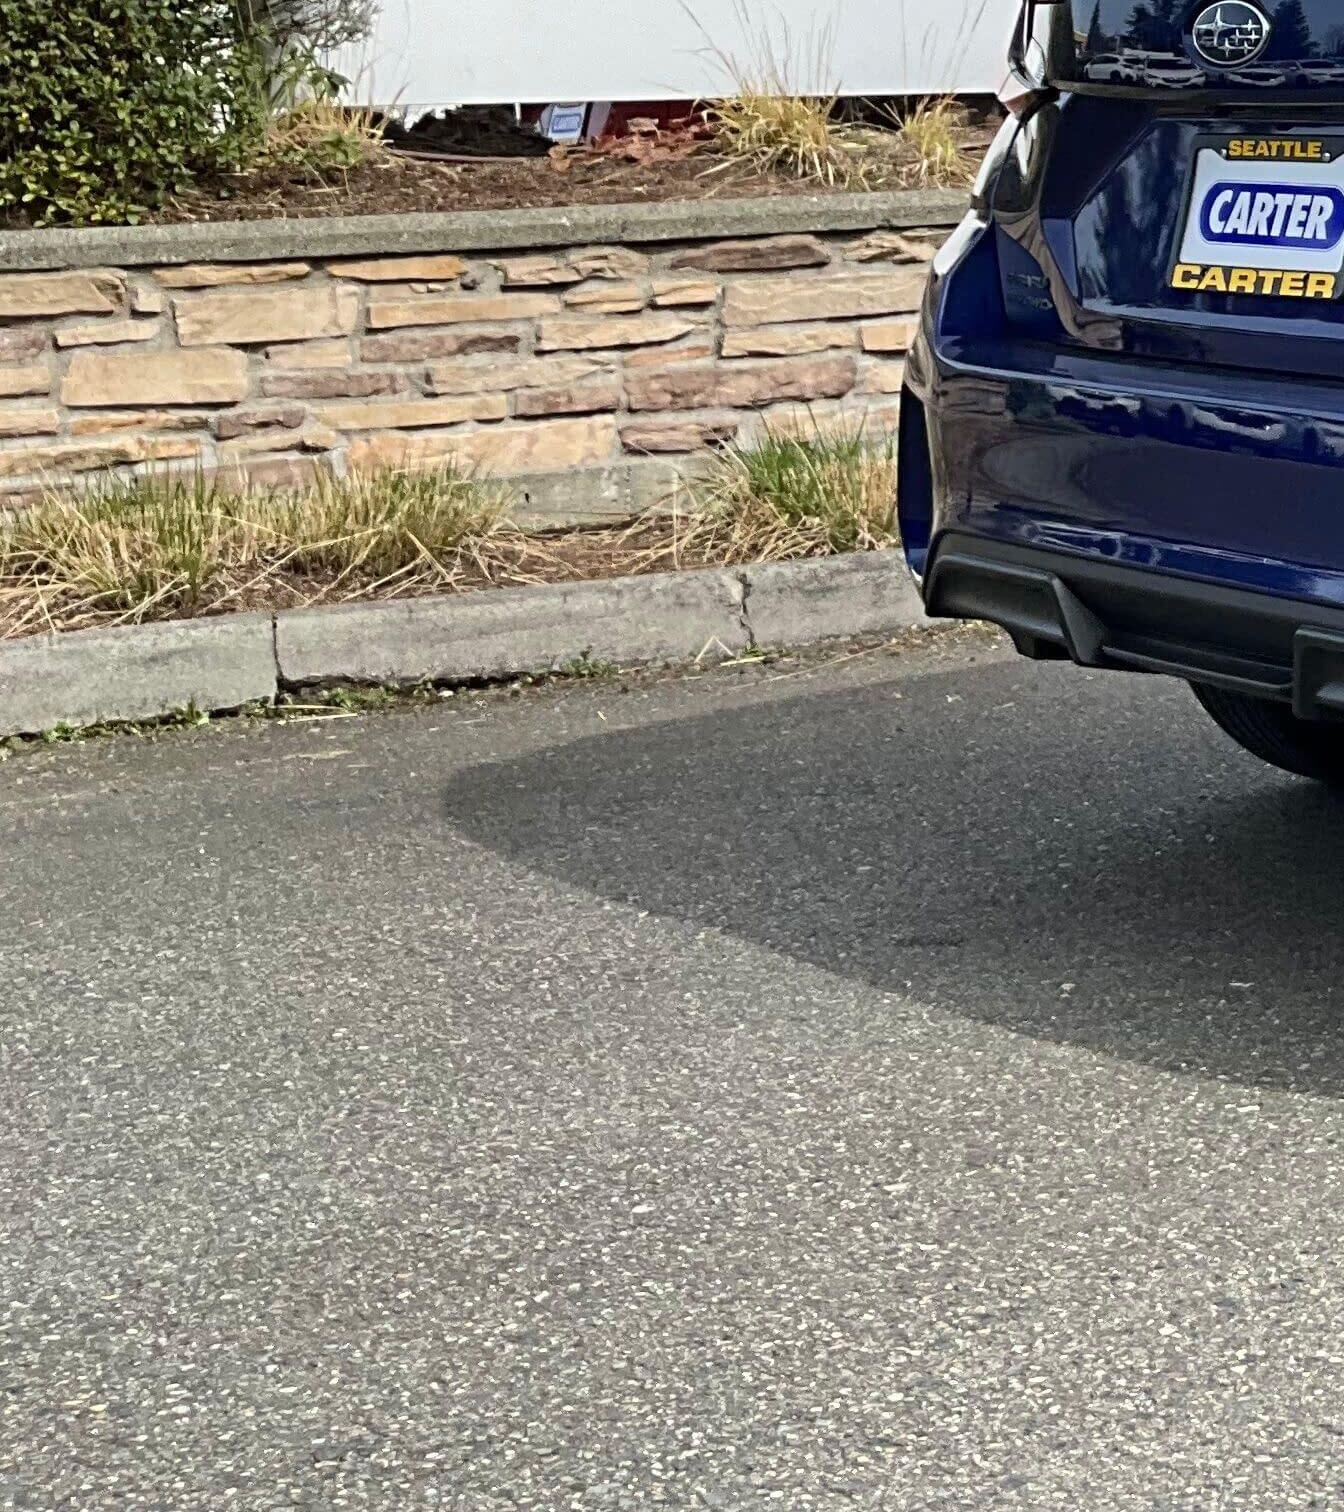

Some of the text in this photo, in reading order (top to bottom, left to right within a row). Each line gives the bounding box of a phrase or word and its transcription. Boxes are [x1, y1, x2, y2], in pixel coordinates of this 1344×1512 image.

[1228, 139, 1323, 158] SEATTLE
[1208, 189, 1334, 240] CARTER
[1171, 263, 1336, 299] CARTER
